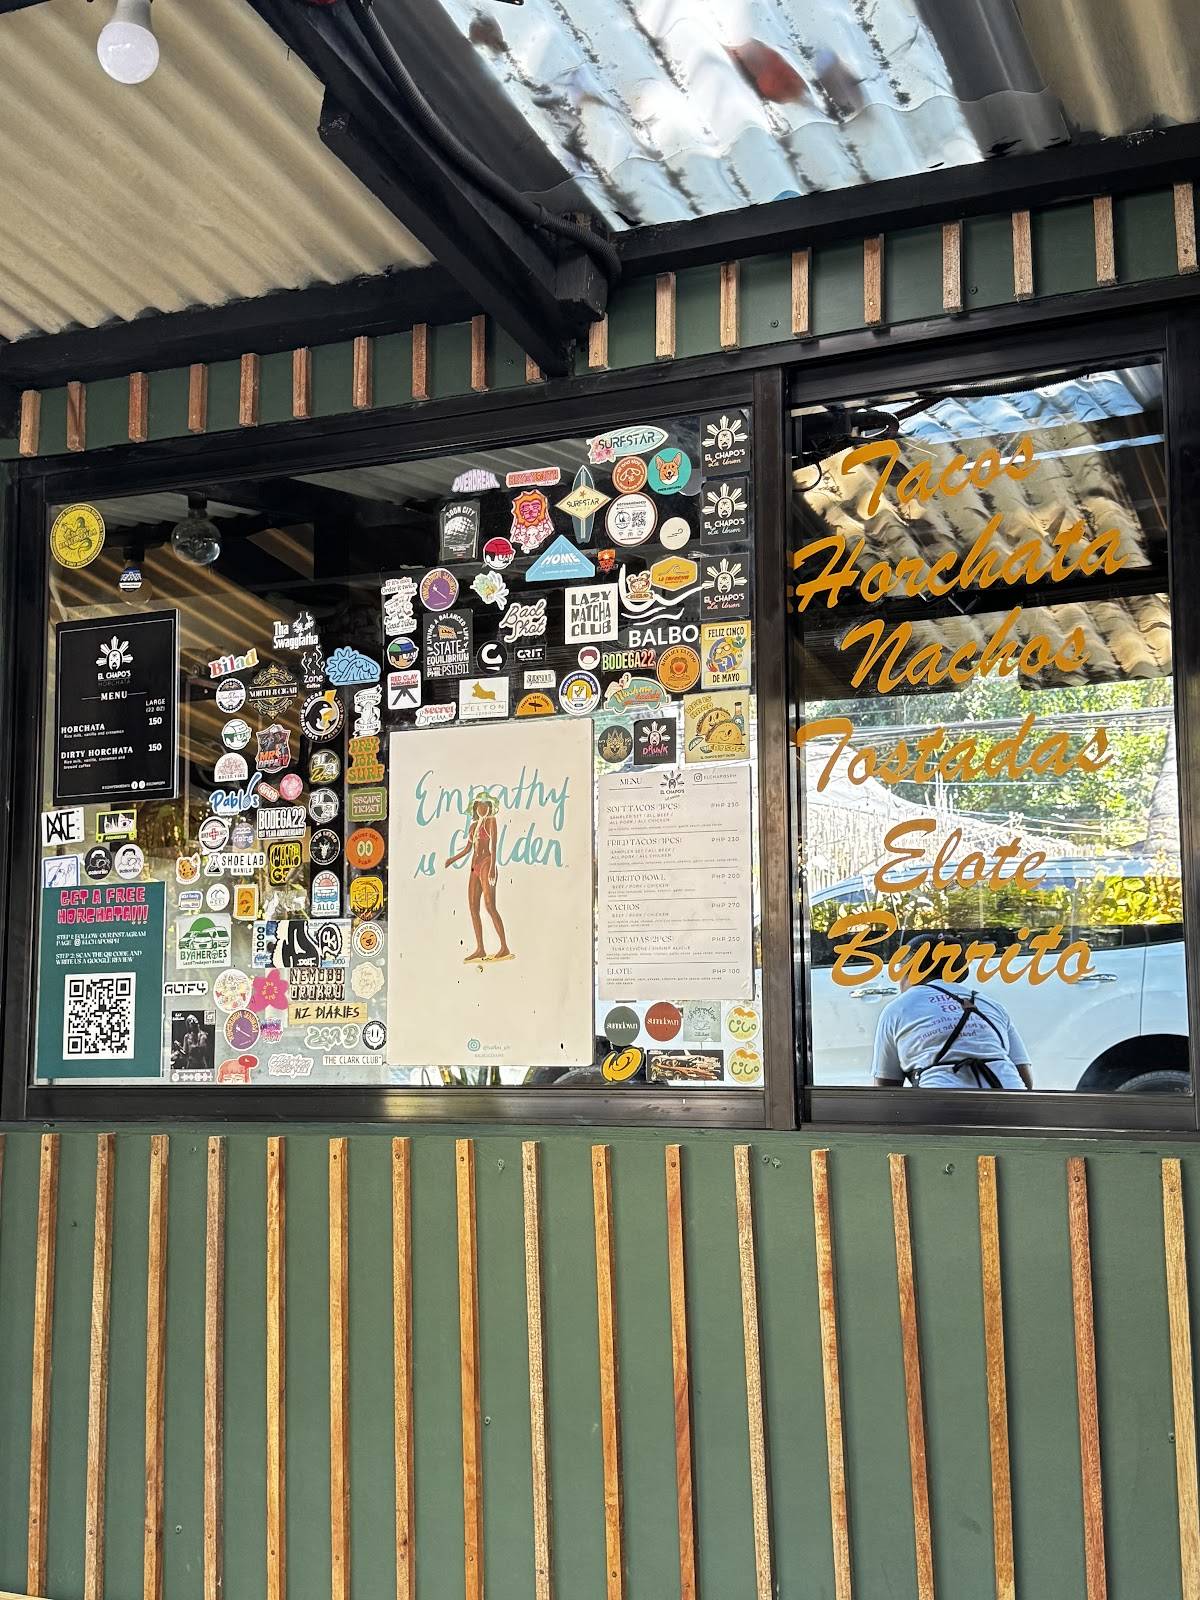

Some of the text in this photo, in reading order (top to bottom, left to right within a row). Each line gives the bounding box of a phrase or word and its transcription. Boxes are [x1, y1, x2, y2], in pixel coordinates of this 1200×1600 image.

[598, 432, 655, 450] SURFSTAR
[705, 450, 746, 462] EL CHAPO'S
[841, 432, 1038, 518] Tacos
[566, 497, 600, 509] SURFSTAR
[446, 506, 475, 518] SOON CITY
[704, 518, 746, 529] EL CHAPO'S
[722, 526, 741, 534] Union
[541, 553, 580, 564] HOME
[792, 511, 1130, 612] Horchata
[572, 590, 611, 606] LAZY
[714, 593, 744, 602] CHAPO'S
[502, 600, 546, 624] Bad
[572, 602, 611, 622] MATCHA
[273, 621, 289, 636] Tha
[439, 613, 466, 627] BALANCED
[462, 626, 470, 640] LIFE
[505, 616, 546, 642] Shot
[572, 620, 611, 636] CLUB
[708, 626, 744, 638] FELIZ CINCO
[628, 624, 699, 648] BALBO
[434, 640, 462, 654] STATE
[840, 606, 1090, 694] Nachos
[517, 649, 544, 658] CRIT
[210, 649, 258, 677] Bilad
[427, 654, 470, 666] EQUILIBRIUM
[602, 649, 656, 672] BODEGA22
[106, 670, 131, 679] CHAPO'S
[304, 674, 324, 683] Zone
[712, 672, 740, 683] DE MAYO
[100, 691, 128, 700] MENU
[304, 690, 323, 707] ORCAS
[145, 698, 166, 706] LARGE
[424, 705, 454, 713] secret
[148, 717, 162, 726] 150
[61, 723, 105, 734] HORCHATA
[61, 746, 134, 759] DIRTY HORCHATA
[148, 743, 162, 752] 150
[642, 744, 668, 755] DRUNK
[795, 712, 1114, 792] Tostadas
[348, 766, 384, 782] SURF
[620, 778, 642, 786] MENU
[353, 796, 380, 804] ESCAPE
[415, 765, 570, 836] Empathy
[353, 804, 380, 814] TICKET
[630, 804, 656, 812] TACOS
[258, 808, 306, 830] BODEGA22
[450, 822, 564, 869] Glden
[607, 838, 629, 846] FRIED
[630, 838, 658, 846] TACOS
[222, 855, 264, 866] SHOE LAB
[874, 818, 1048, 893] Elote
[60, 886, 146, 906] GET A FREE
[58, 904, 149, 925] HORCHATA!!!
[256, 926, 265, 952] 1000
[608, 936, 649, 944] TOSTADAS
[828, 910, 1096, 986] Burrito
[294, 1006, 360, 1020] NZ DIARIES
[324, 1056, 360, 1064] THE CLARK
